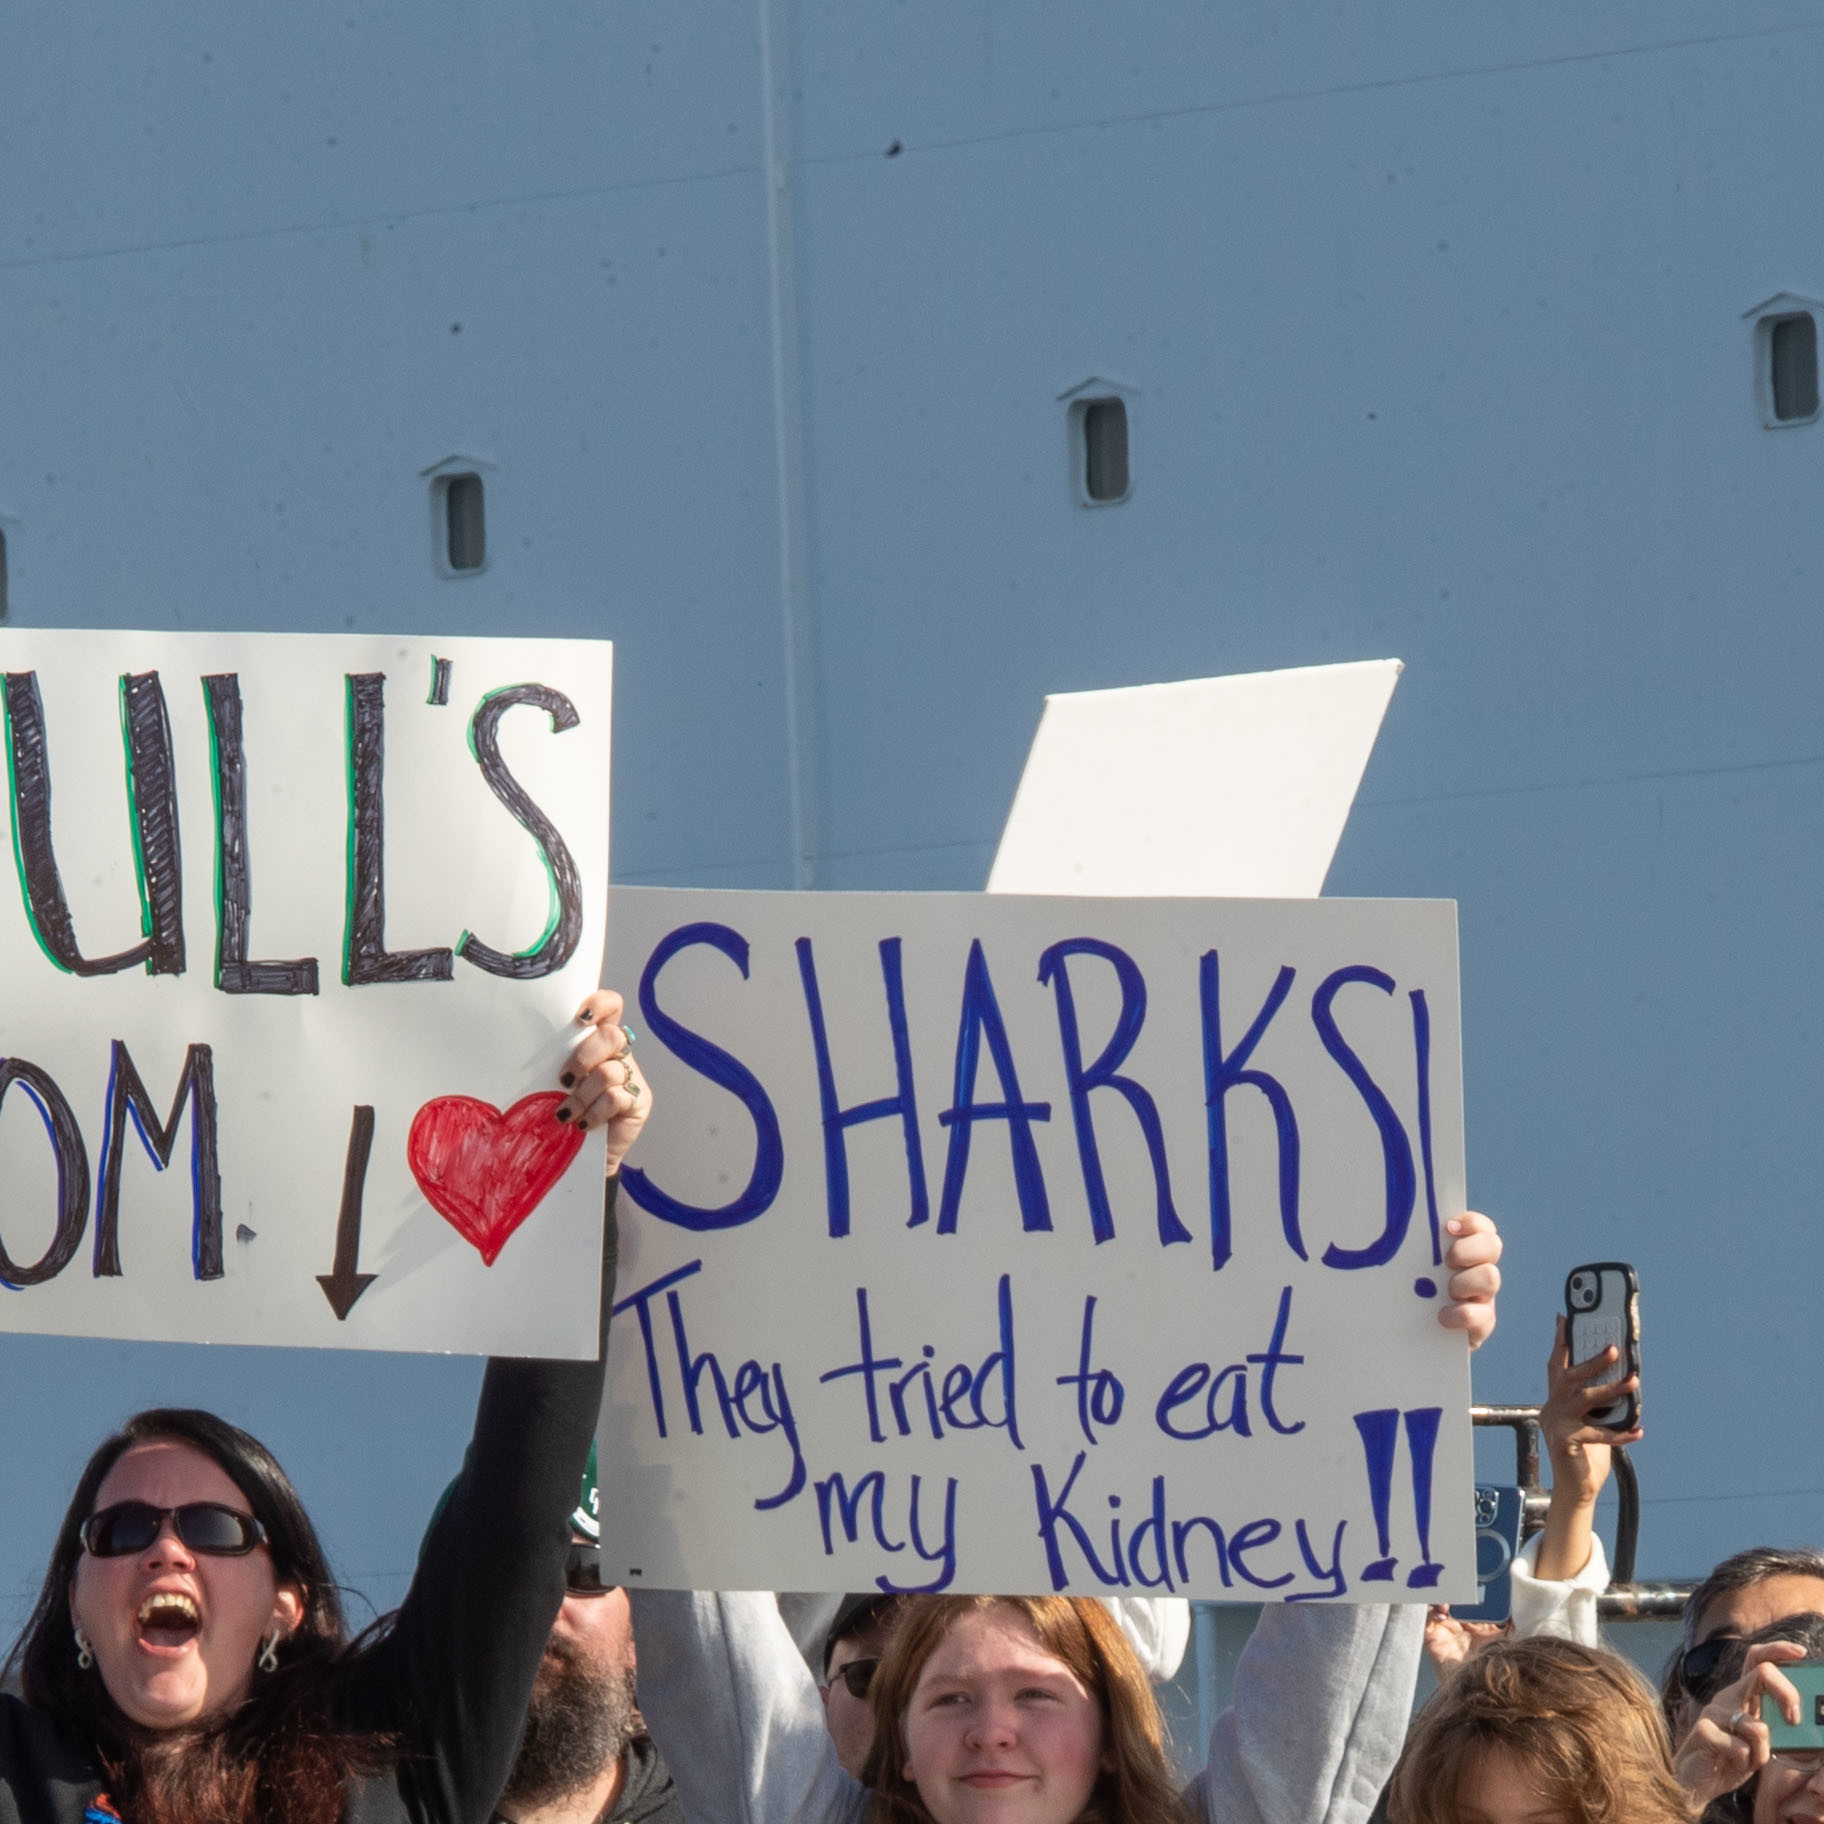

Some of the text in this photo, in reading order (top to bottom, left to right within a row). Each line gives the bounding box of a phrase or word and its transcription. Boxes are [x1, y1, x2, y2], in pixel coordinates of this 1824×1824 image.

[620, 921, 1444, 1300] SHARKS!
[611, 1259, 1306, 1510] They tried to eat
[814, 1408, 1444, 1604] my Kidney!!
